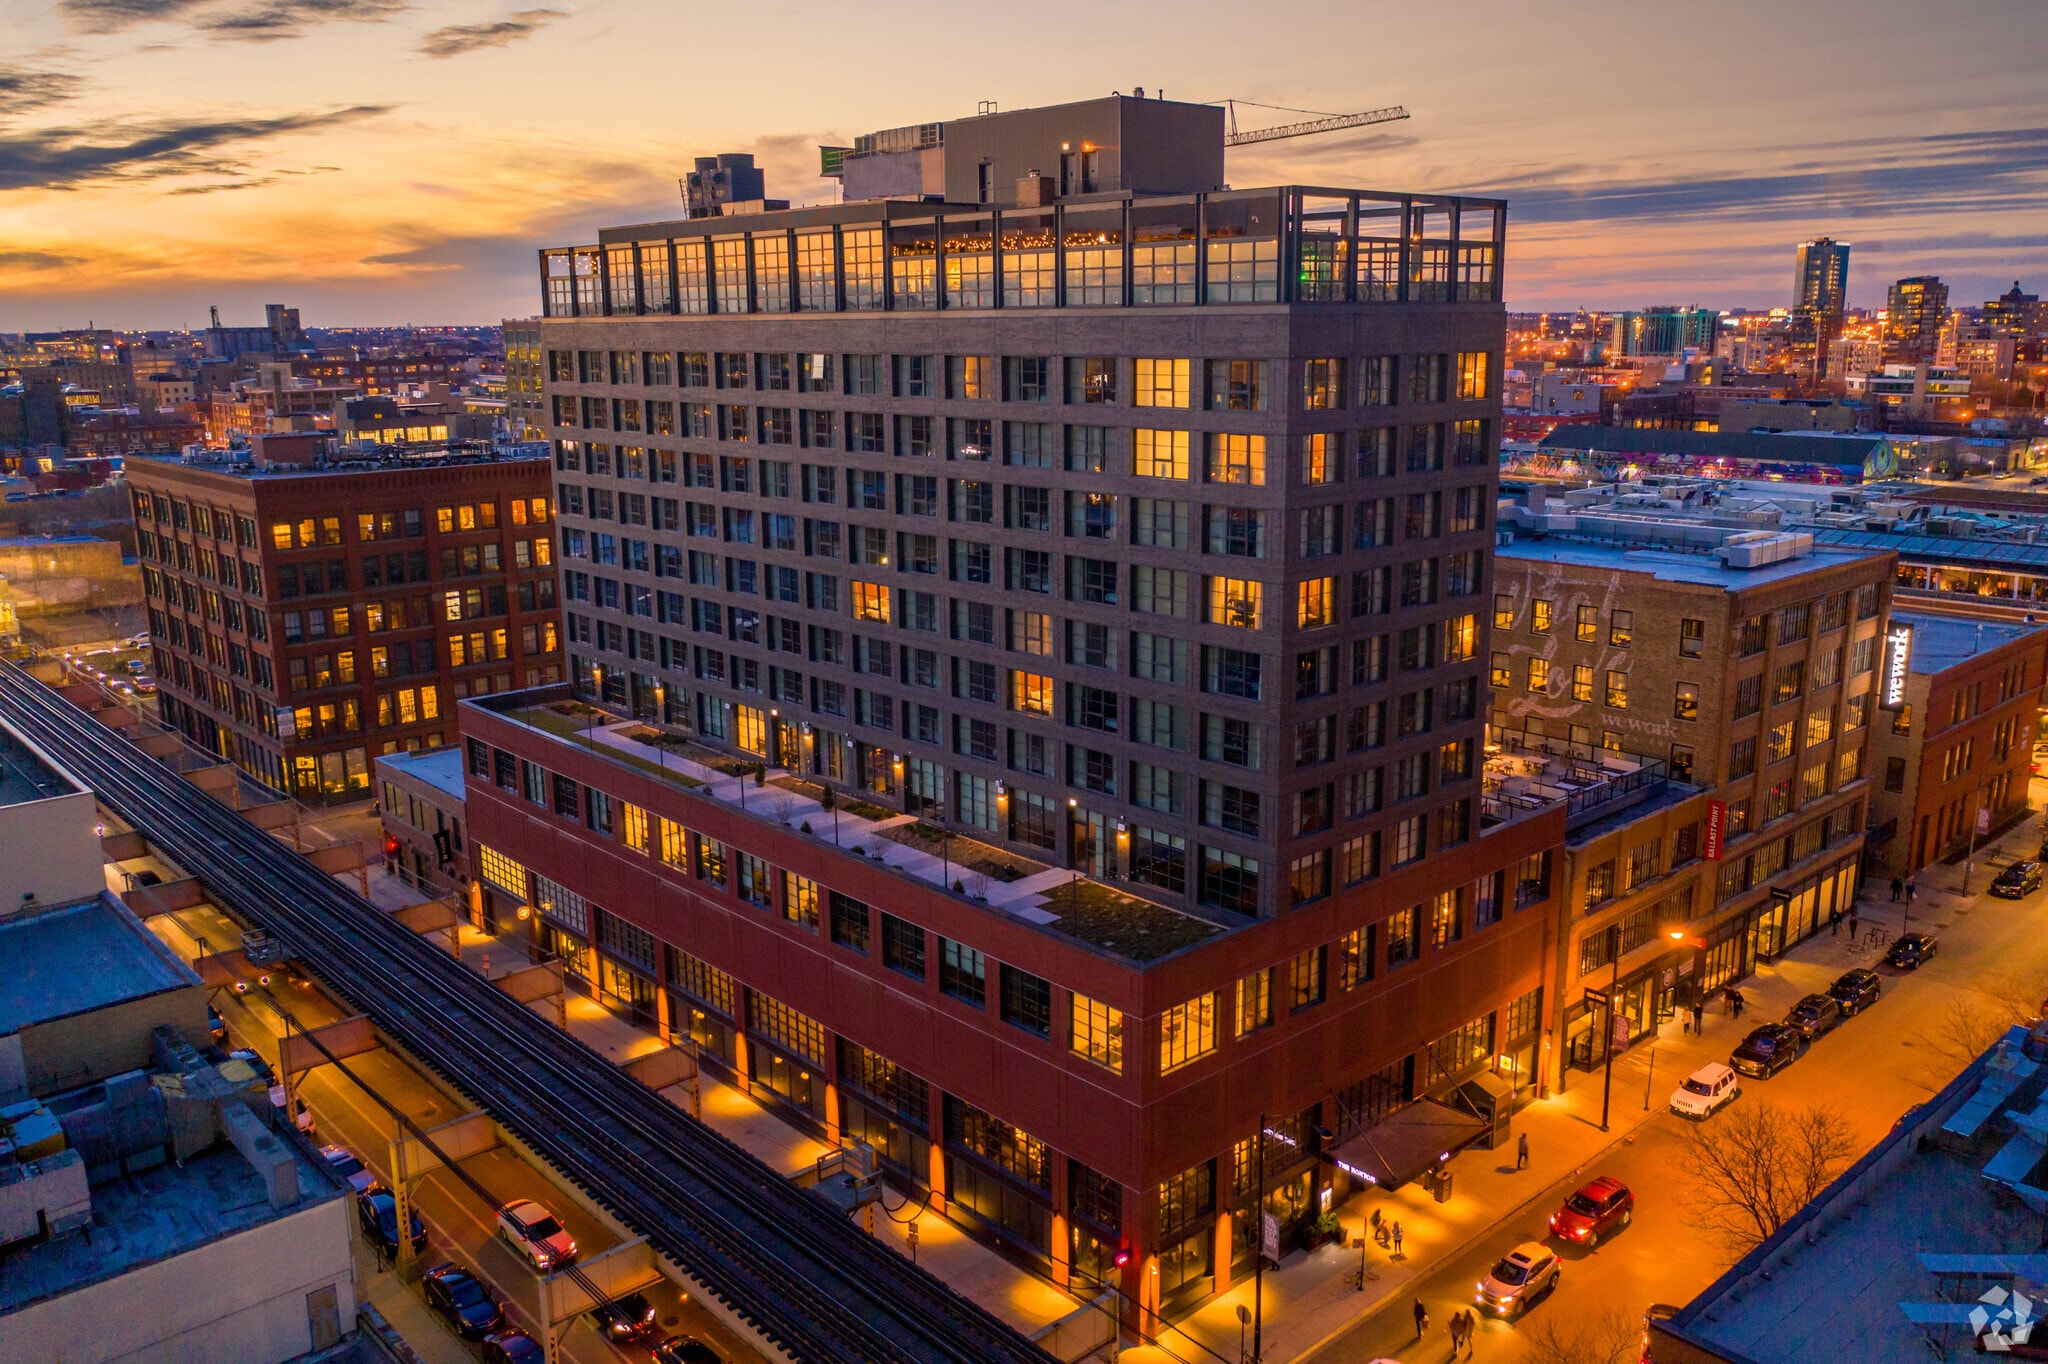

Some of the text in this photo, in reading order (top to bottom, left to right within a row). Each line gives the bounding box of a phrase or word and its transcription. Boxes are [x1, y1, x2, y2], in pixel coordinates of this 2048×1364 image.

[1888, 628, 1909, 705] wework
[1600, 713, 1678, 738] wework
[1708, 804, 1719, 858] BALLAST POINT
